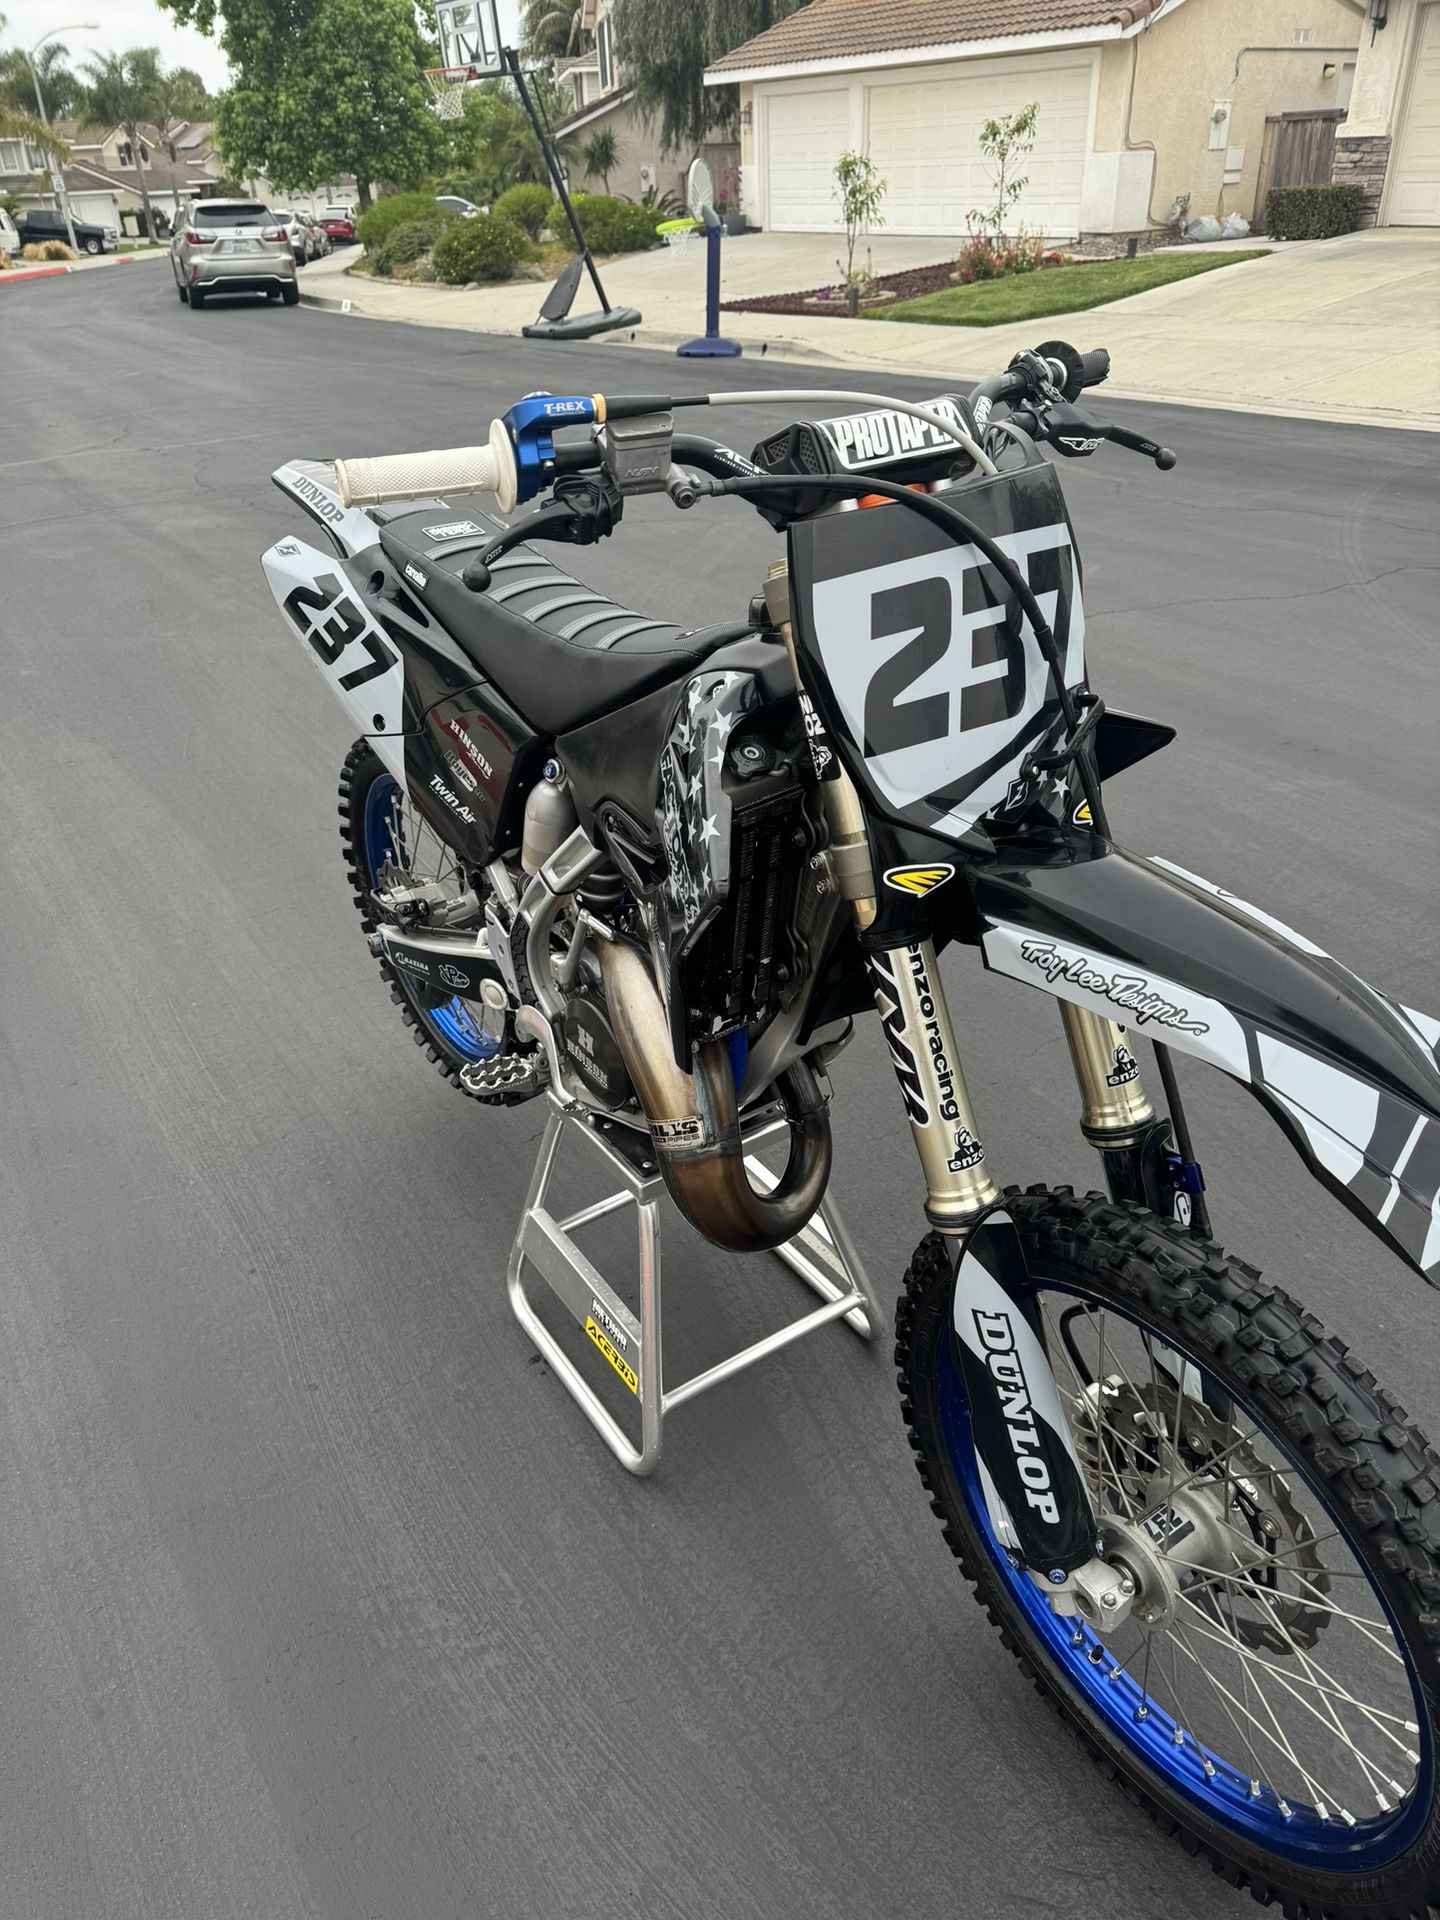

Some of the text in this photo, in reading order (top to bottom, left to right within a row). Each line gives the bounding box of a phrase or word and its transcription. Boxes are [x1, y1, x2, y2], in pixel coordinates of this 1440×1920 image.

[544, 401, 586, 414] T-REX
[292, 476, 345, 523] DUNLOP
[283, 572, 400, 692] 237
[864, 543, 1074, 759] 237
[449, 719, 494, 777] HINSON
[429, 774, 461, 809] Twin
[455, 805, 478, 825] Air
[1021, 940, 1211, 1034] Troy Lee Designs
[577, 1024, 595, 1057] H
[971, 1308, 1061, 1525] DUNLOP
